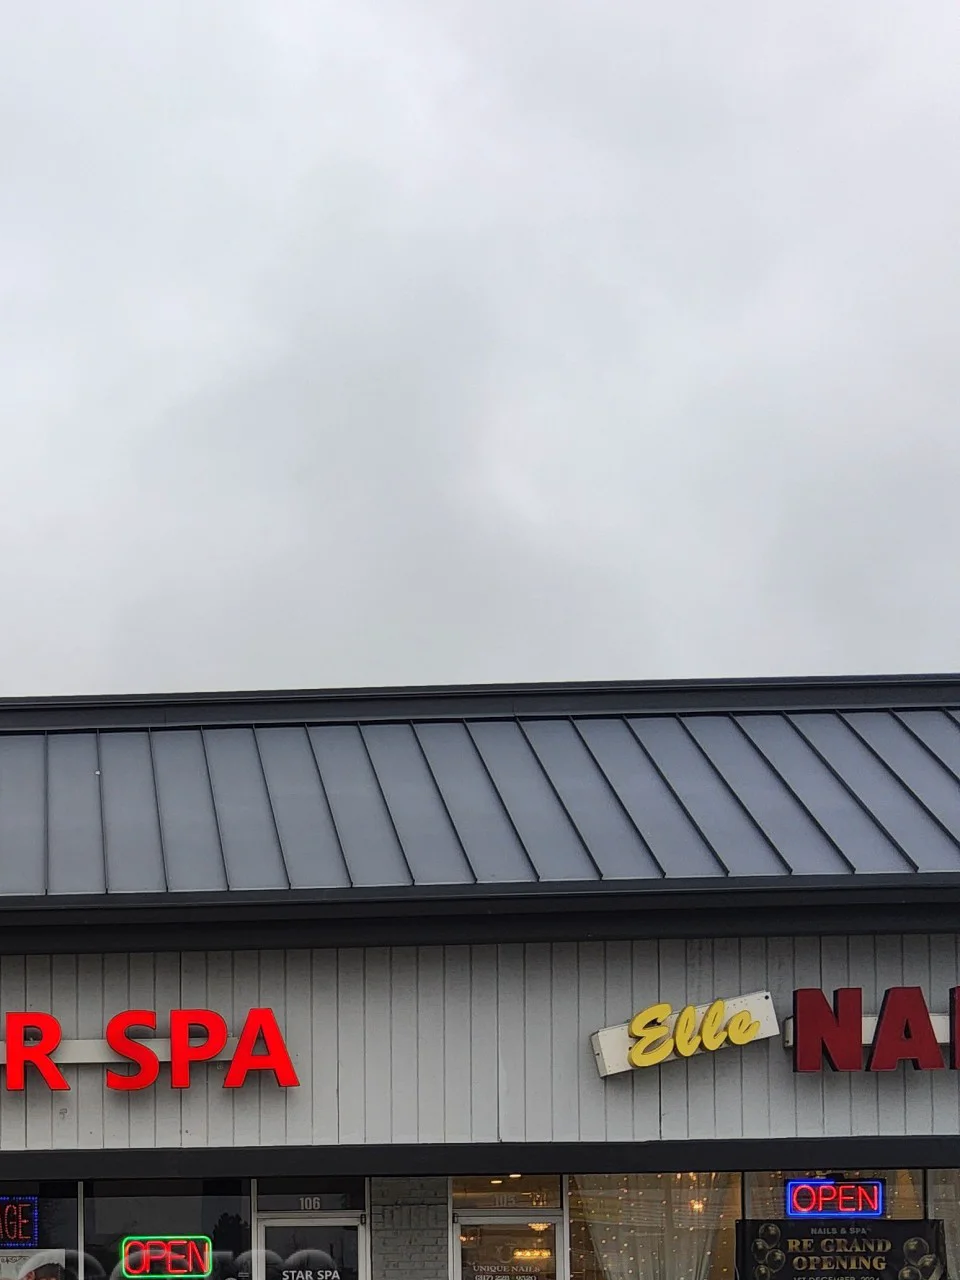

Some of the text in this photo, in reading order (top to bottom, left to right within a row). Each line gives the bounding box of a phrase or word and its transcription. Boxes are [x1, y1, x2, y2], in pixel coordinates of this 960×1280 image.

[628, 998, 761, 1068] Elle
[106, 1007, 300, 1090] SPA
[299, 1197, 321, 1210] 106
[792, 1184, 879, 1213] OPEN
[787, 1238, 892, 1253] RE GRAND
[124, 1240, 209, 1275] OPEN
[792, 1255, 887, 1270] OPENING
[282, 1270, 341, 1280] STAR SPA
